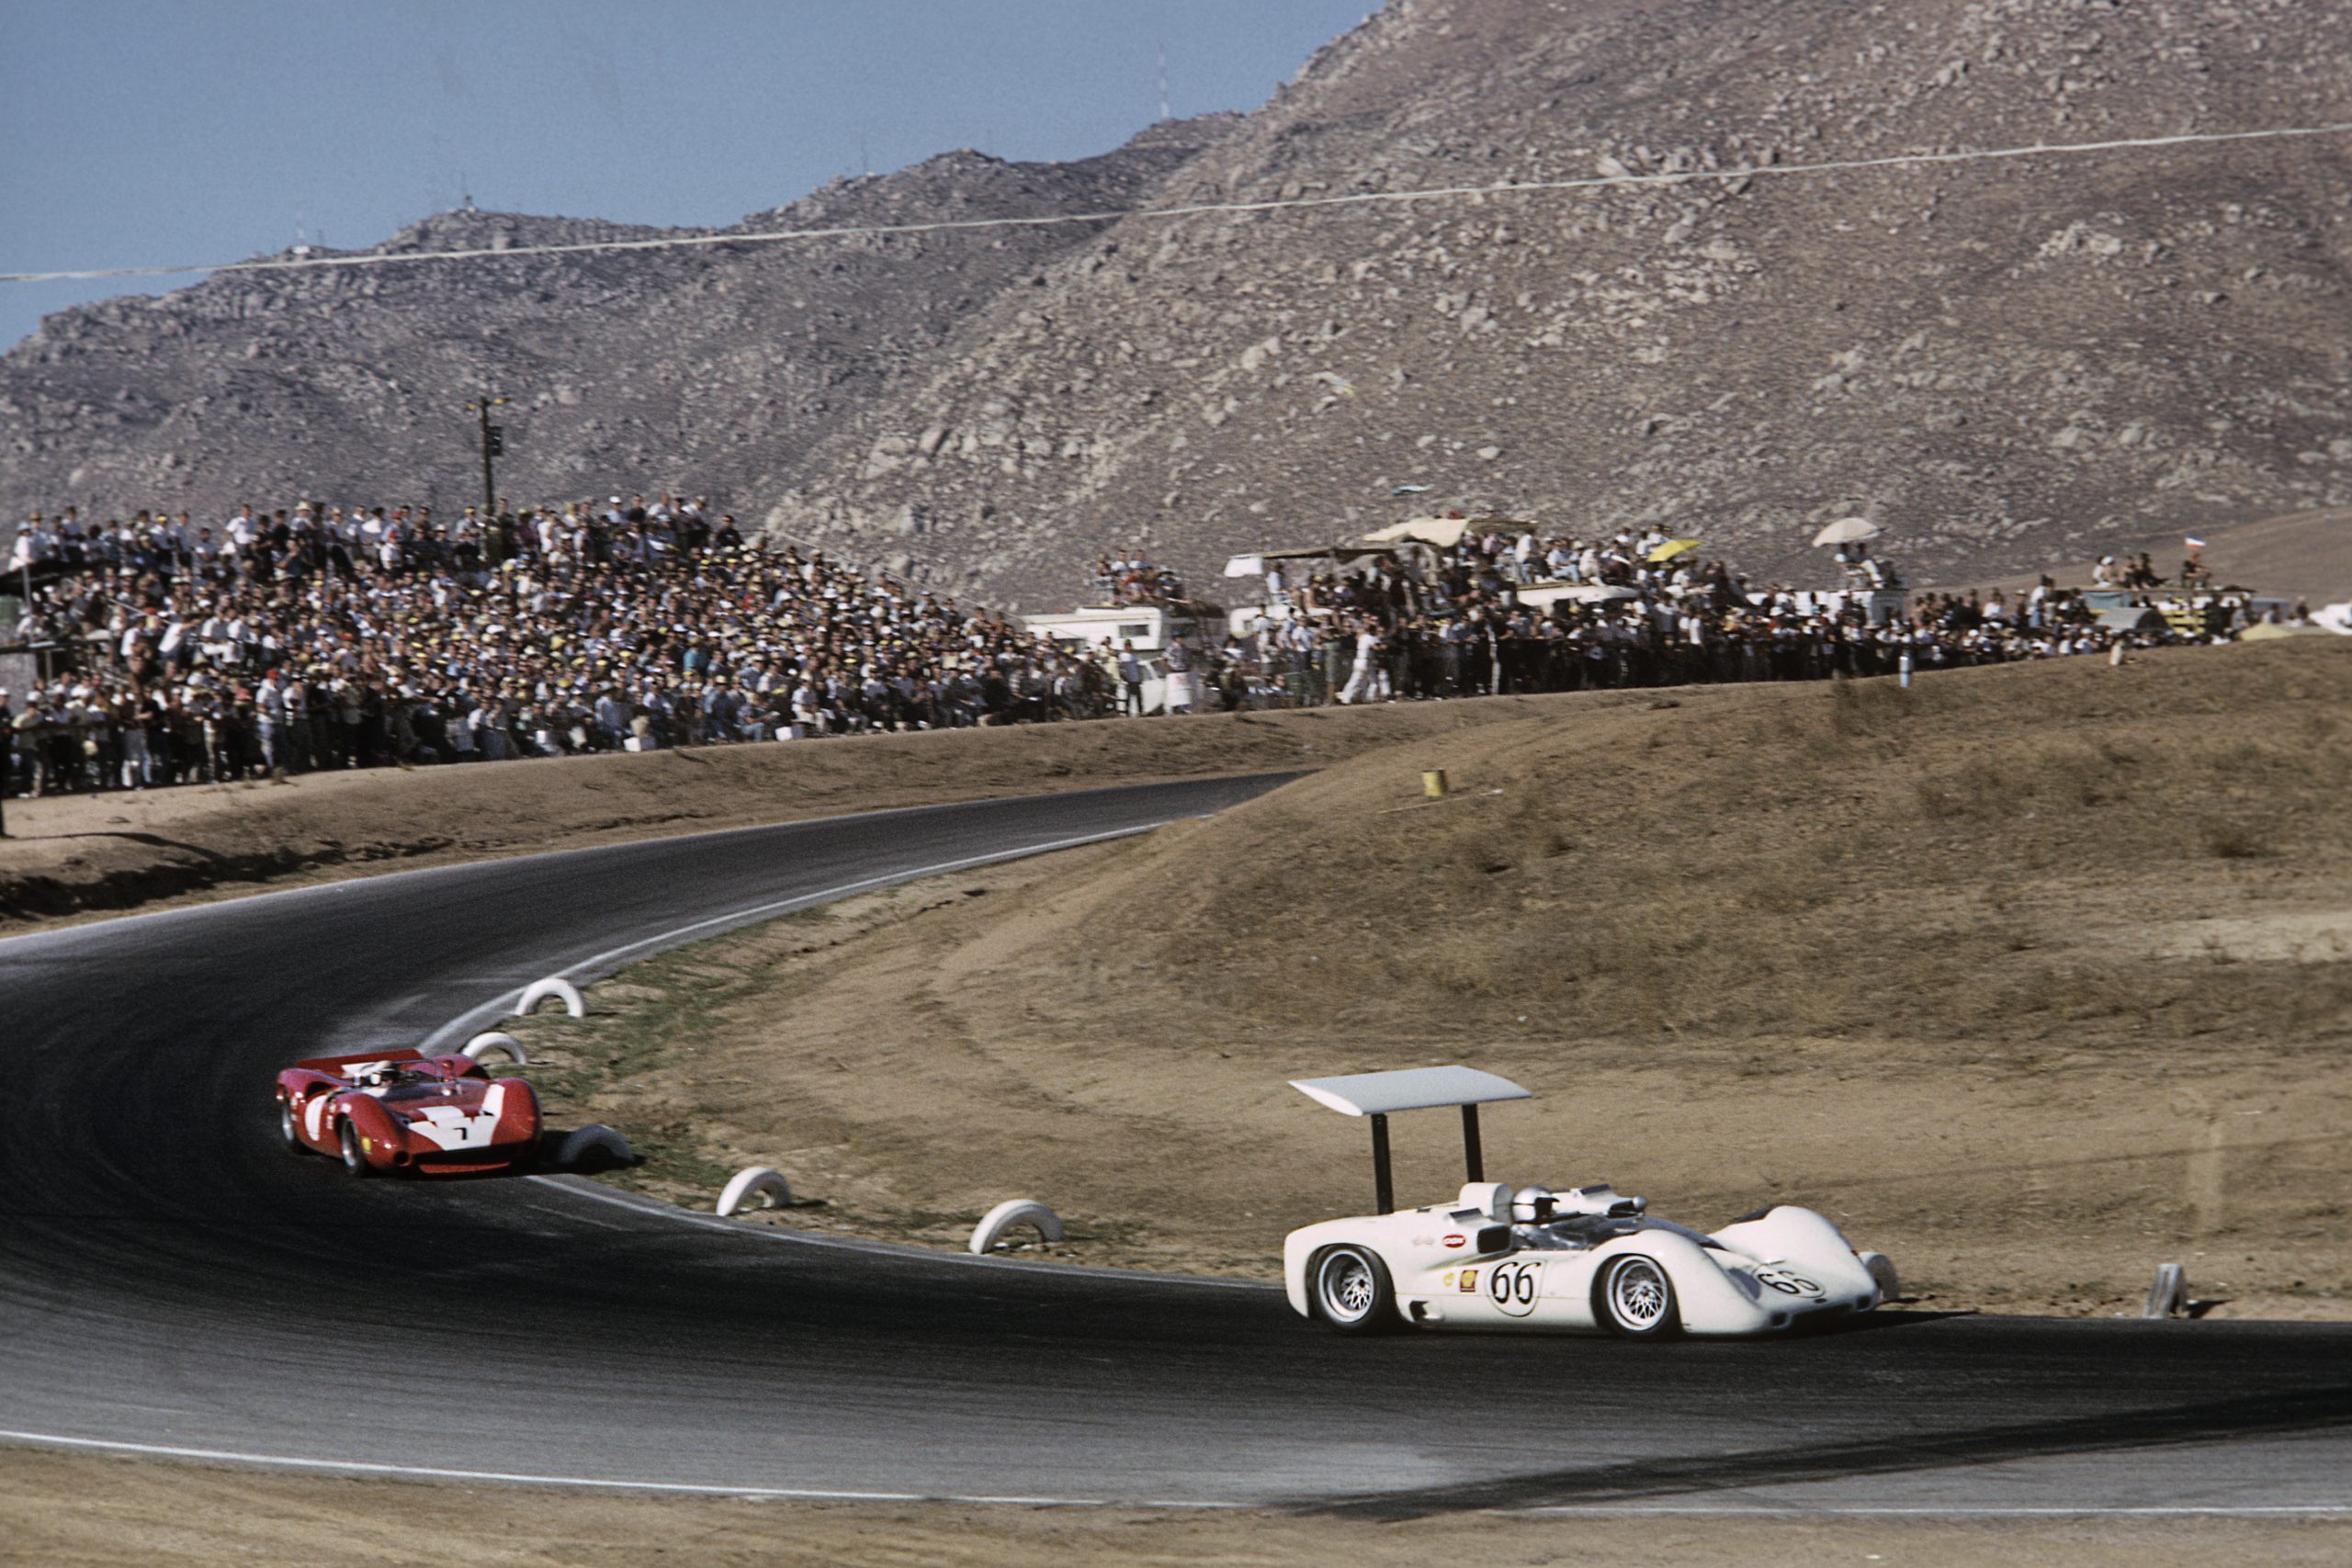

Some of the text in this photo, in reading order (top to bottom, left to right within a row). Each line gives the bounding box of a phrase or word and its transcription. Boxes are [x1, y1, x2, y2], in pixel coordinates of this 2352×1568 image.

[453, 1127, 467, 1140] 7
[1491, 1262, 1541, 1304] 66
[1758, 1271, 1819, 1293] 66
